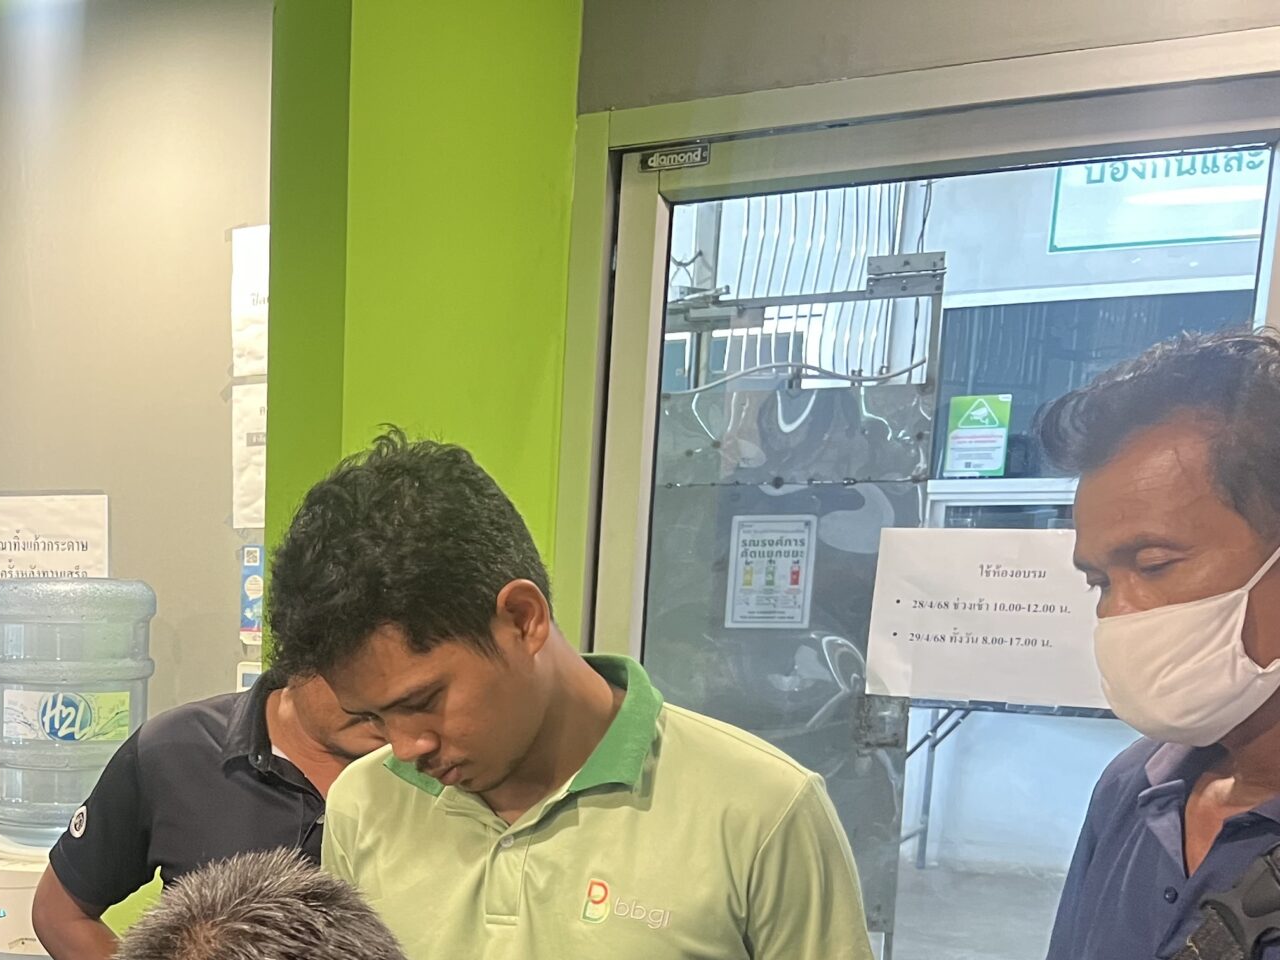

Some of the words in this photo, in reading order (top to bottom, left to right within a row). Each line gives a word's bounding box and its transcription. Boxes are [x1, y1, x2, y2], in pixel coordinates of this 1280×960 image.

[647, 147, 702, 168] diamond
[979, 563, 1047, 580] ใช้ห้องอบรม
[912, 599, 950, 611] 28/4/68
[993, 601, 1056, 614] 10.00-12.00
[908, 632, 947, 644] 29/4/68
[981, 636, 1038, 648] 8.00-17.00
